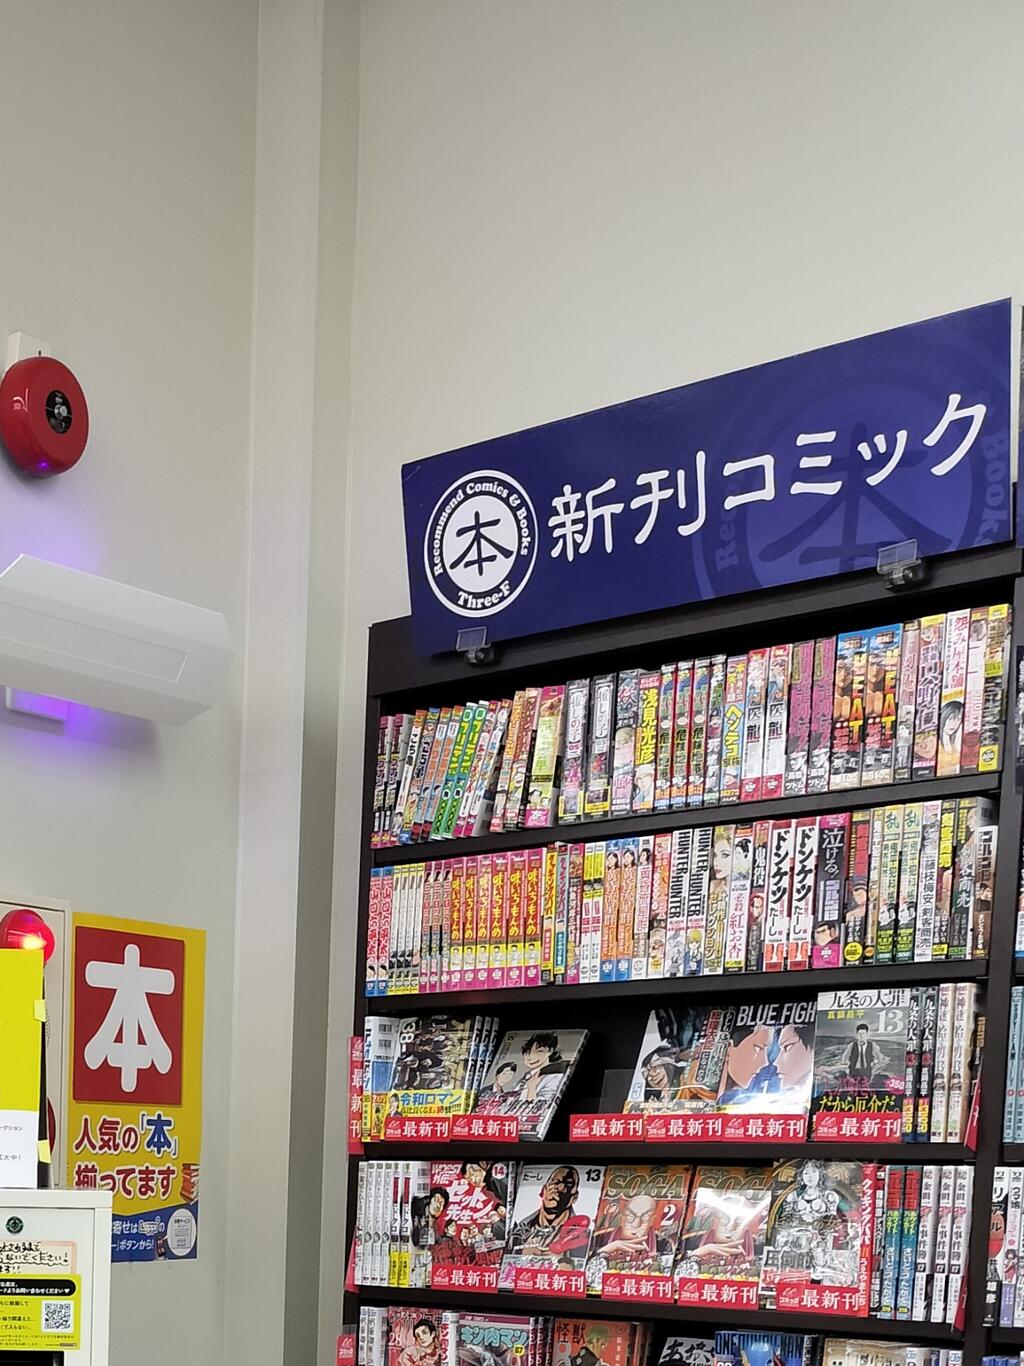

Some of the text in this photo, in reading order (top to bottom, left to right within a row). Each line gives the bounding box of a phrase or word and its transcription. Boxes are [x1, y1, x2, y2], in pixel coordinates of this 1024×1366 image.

[547, 393, 989, 563] 新刊コミック
[433, 482, 531, 576] Recommend Comics & Books
[450, 511, 514, 576] 本
[457, 580, 511, 608] Three-F
[669, 831, 691, 919] HUNTER HUNTER
[688, 828, 711, 918] HUNTER HUNTER
[770, 830, 791, 904] ドンケツ
[795, 827, 815, 903] ドンケツ
[829, 990, 906, 1008] 九条の大罪
[84, 944, 175, 1093] 本
[736, 1004, 780, 1027] BLUE
[875, 1009, 904, 1034] 13
[400, 1092, 462, 1106] 令和ロマン
[75, 1113, 179, 1157] 人気の「本」
[403, 1120, 449, 1138] 最新刊
[470, 1119, 517, 1137] 最新刊
[590, 1119, 643, 1137] 最新刊
[667, 1119, 722, 1138] 最新刊
[746, 1119, 804, 1138] 最新刊
[840, 1117, 901, 1137] 最新刊
[75, 1164, 176, 1200] 揃ってます
[522, 1172, 544, 1182] たーし
[584, 1168, 601, 1183] 13
[662, 1204, 676, 1226] 2
[450, 1270, 498, 1288] 最新刊
[533, 1273, 584, 1293] 最新刊
[621, 1278, 673, 1299] 最新刊
[700, 1283, 757, 1305] 最新刊
[801, 1289, 859, 1311] 最新刊
